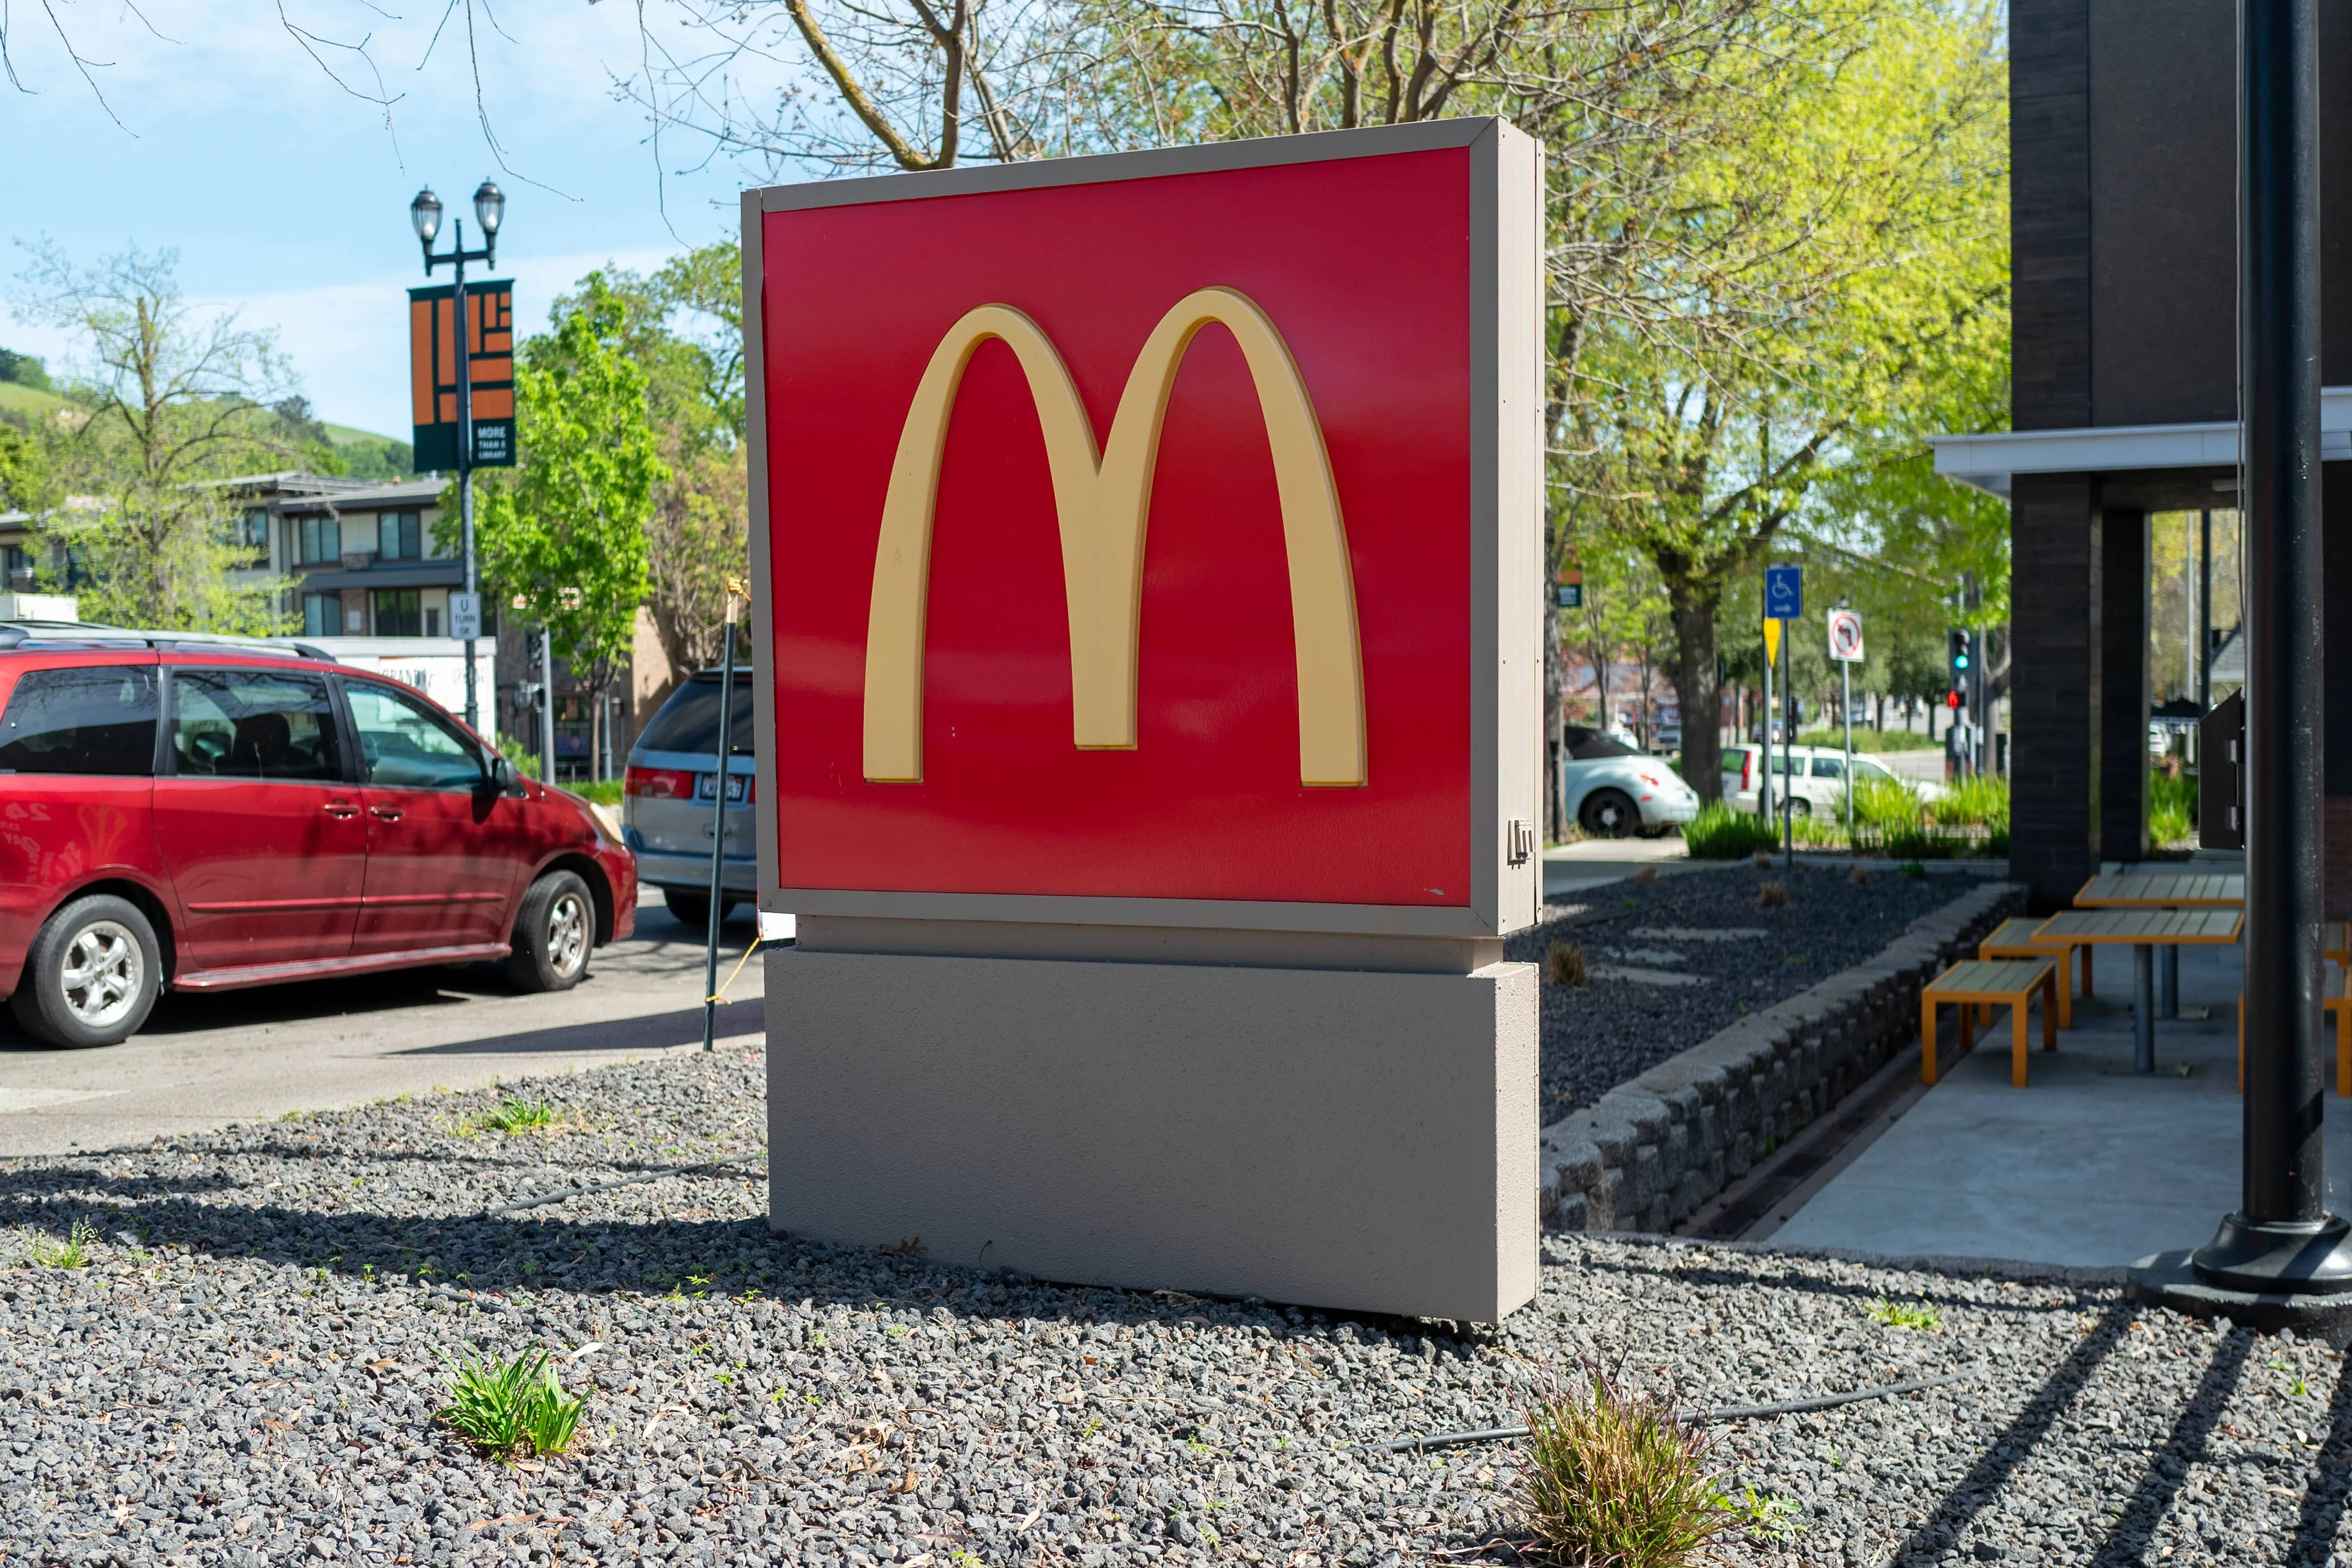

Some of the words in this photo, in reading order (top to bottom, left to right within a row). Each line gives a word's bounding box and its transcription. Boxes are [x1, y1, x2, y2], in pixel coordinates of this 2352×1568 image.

[478, 426, 506, 439] MORE
[478, 440, 499, 449] THAN
[478, 450, 507, 459] LIBRARY
[863, 285, 1367, 787] M
[461, 599, 468, 612] U
[454, 613, 475, 625] TURN
[459, 626, 470, 636] OK
